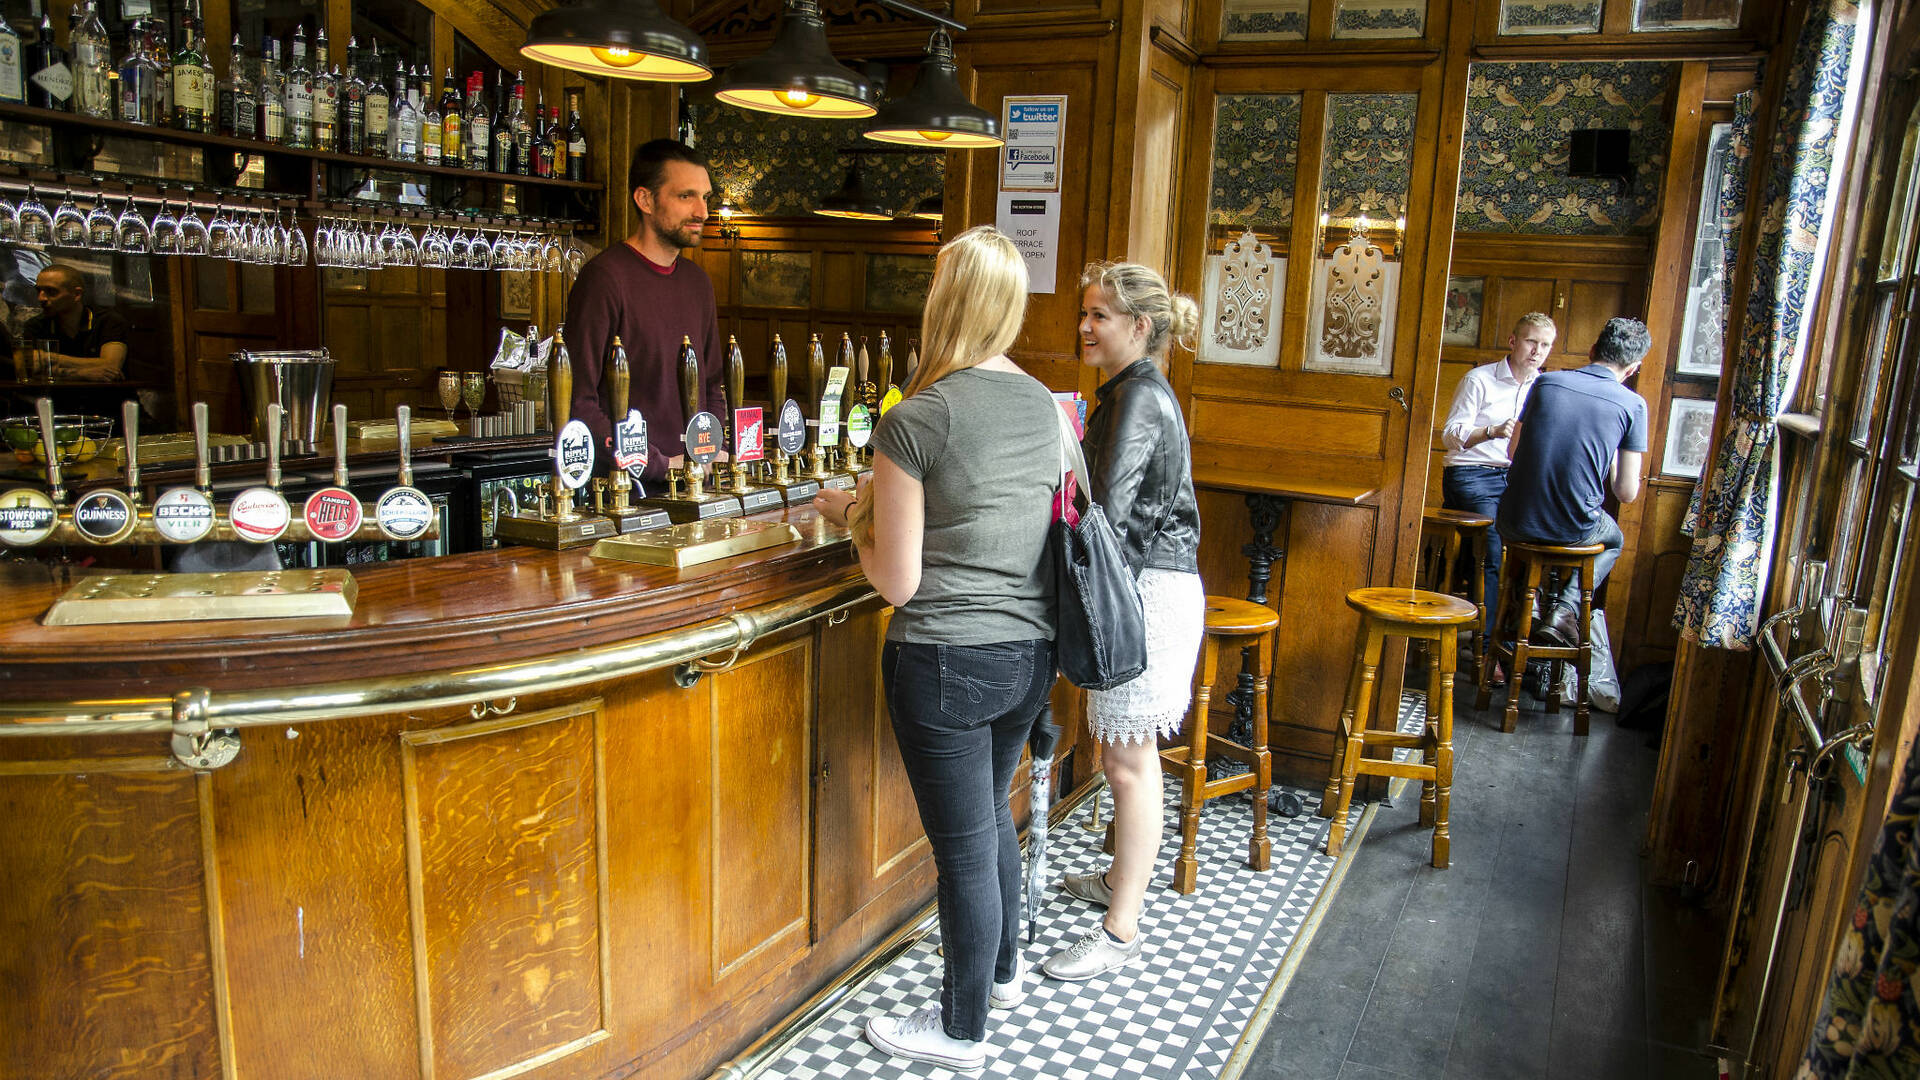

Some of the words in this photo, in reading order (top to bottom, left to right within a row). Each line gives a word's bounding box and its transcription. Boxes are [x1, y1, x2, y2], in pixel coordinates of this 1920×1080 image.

[1022, 112, 1058, 121] twitter
[1020, 153, 1050, 161] Facebook
[1016, 229, 1038, 237] ROOF
[1024, 251, 1046, 259] OPEN
[623, 436, 646, 446] RIPPLE
[698, 431, 711, 444] RYE
[564, 447, 588, 458] RIPPLE
[321, 496, 350, 505] CAMDEN
[0, 510, 48, 521] STOWFORD
[79, 509, 126, 520] GUINNESS
[317, 503, 350, 525] HELLS
[10, 520, 36, 529] PRESS
[167, 519, 201, 528] VIER
